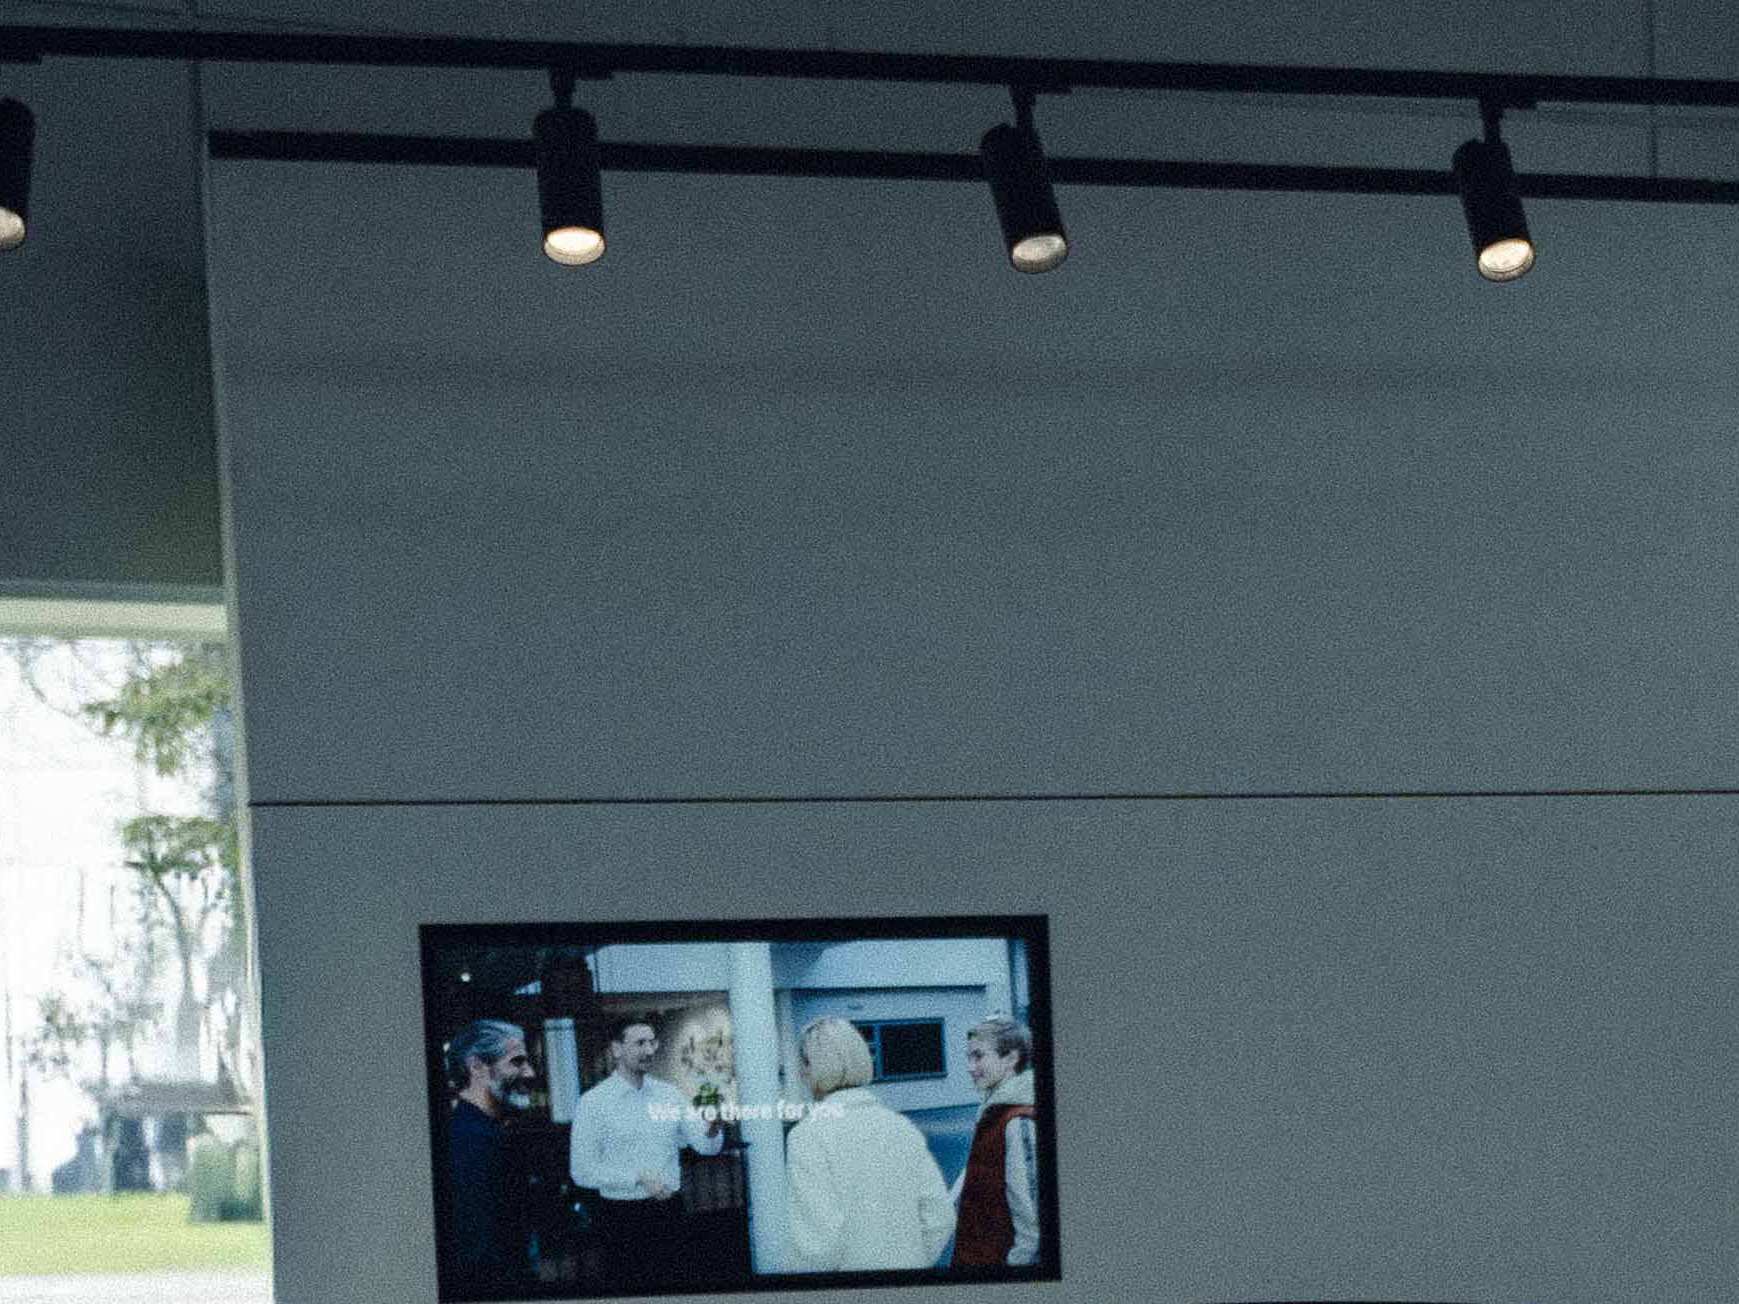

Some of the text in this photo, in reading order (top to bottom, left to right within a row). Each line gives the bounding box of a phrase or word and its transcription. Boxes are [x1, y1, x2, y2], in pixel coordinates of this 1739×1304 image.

[647, 1102, 681, 1121] We
[720, 1101, 773, 1120] there
[776, 1099, 806, 1120] for
[808, 1102, 845, 1122] you
